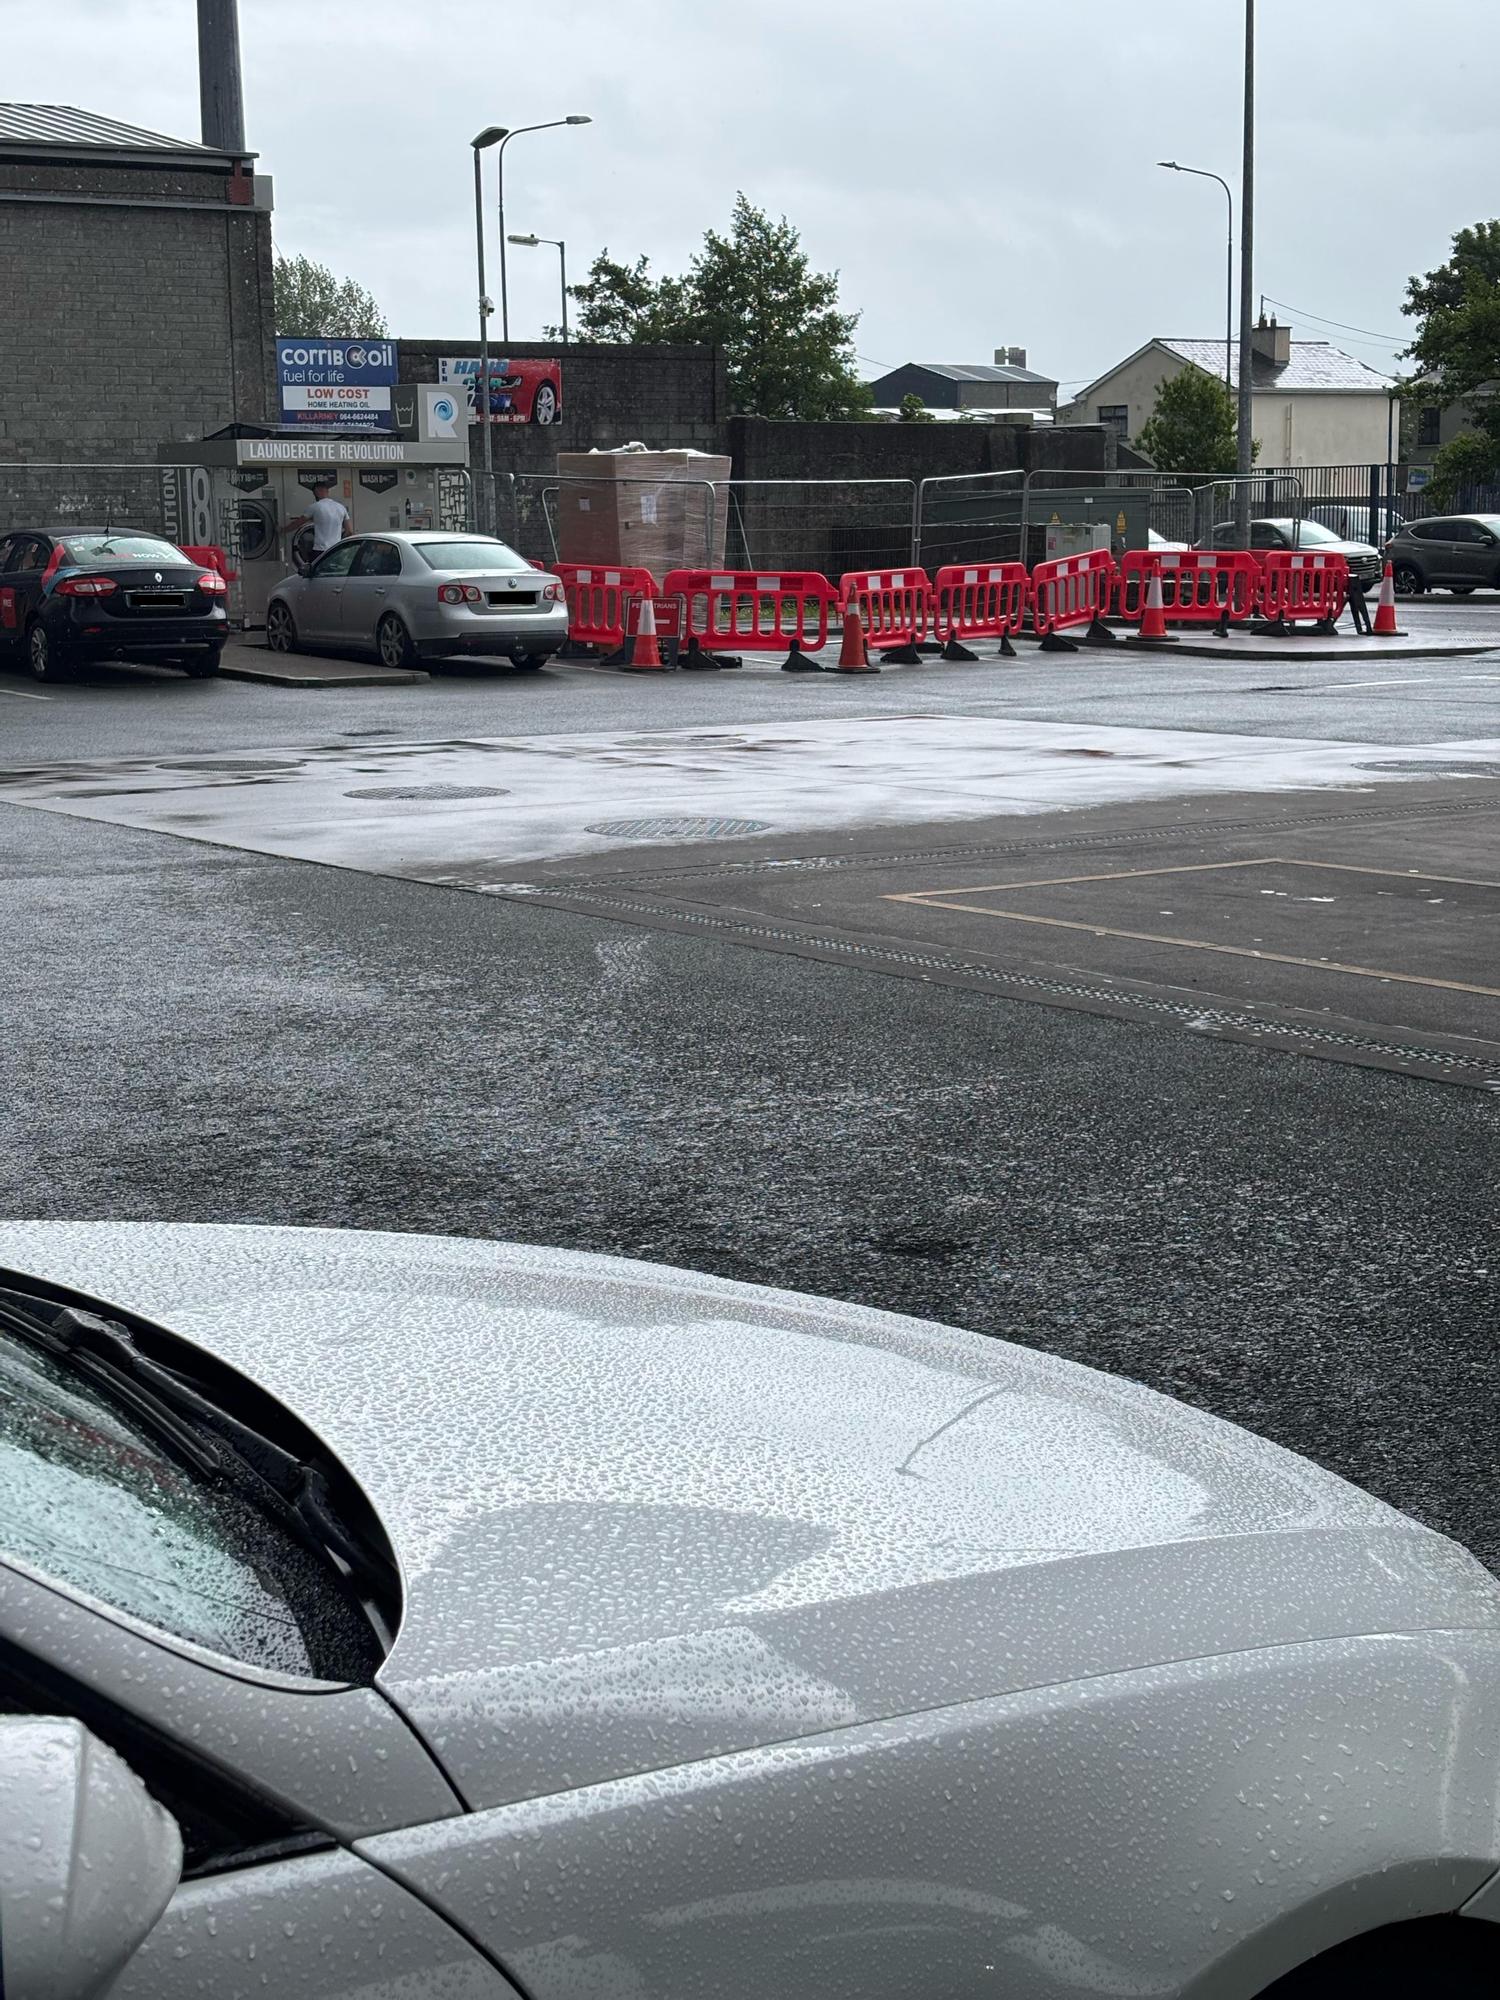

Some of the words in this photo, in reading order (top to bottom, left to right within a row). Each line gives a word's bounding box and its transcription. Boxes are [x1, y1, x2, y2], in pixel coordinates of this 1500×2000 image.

[367, 345, 393, 366] oil
[283, 369, 305, 382] fuel
[308, 369, 325, 382] for
[328, 369, 345, 382] life
[307, 388, 334, 399] LOW
[338, 388, 370, 399] COST
[250, 443, 335, 459] LAUNDERETTE
[340, 444, 404, 460] REVOLUTION
